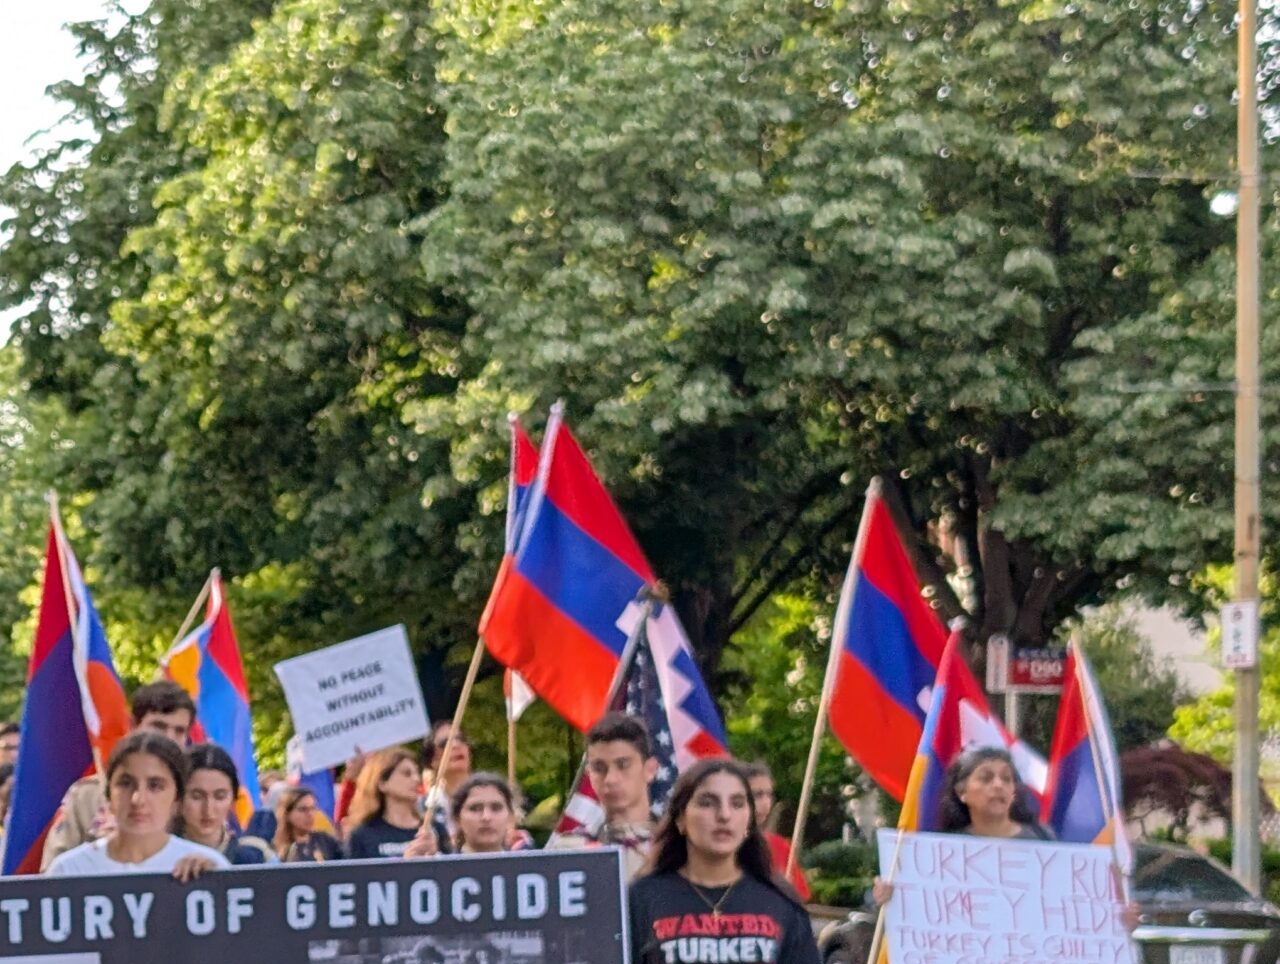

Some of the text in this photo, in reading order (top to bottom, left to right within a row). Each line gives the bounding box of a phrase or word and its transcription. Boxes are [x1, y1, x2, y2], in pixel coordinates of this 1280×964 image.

[326, 683, 385, 712] WITHOUT
[305, 698, 416, 742] ACCOUNTABILITY
[185, 886, 255, 935] OF
[286, 870, 588, 930] GENOCIDE
[653, 912, 783, 940] WANTED
[660, 937, 777, 964] TURKEY
[897, 926, 1125, 964] TURKEY IS GUILTY
